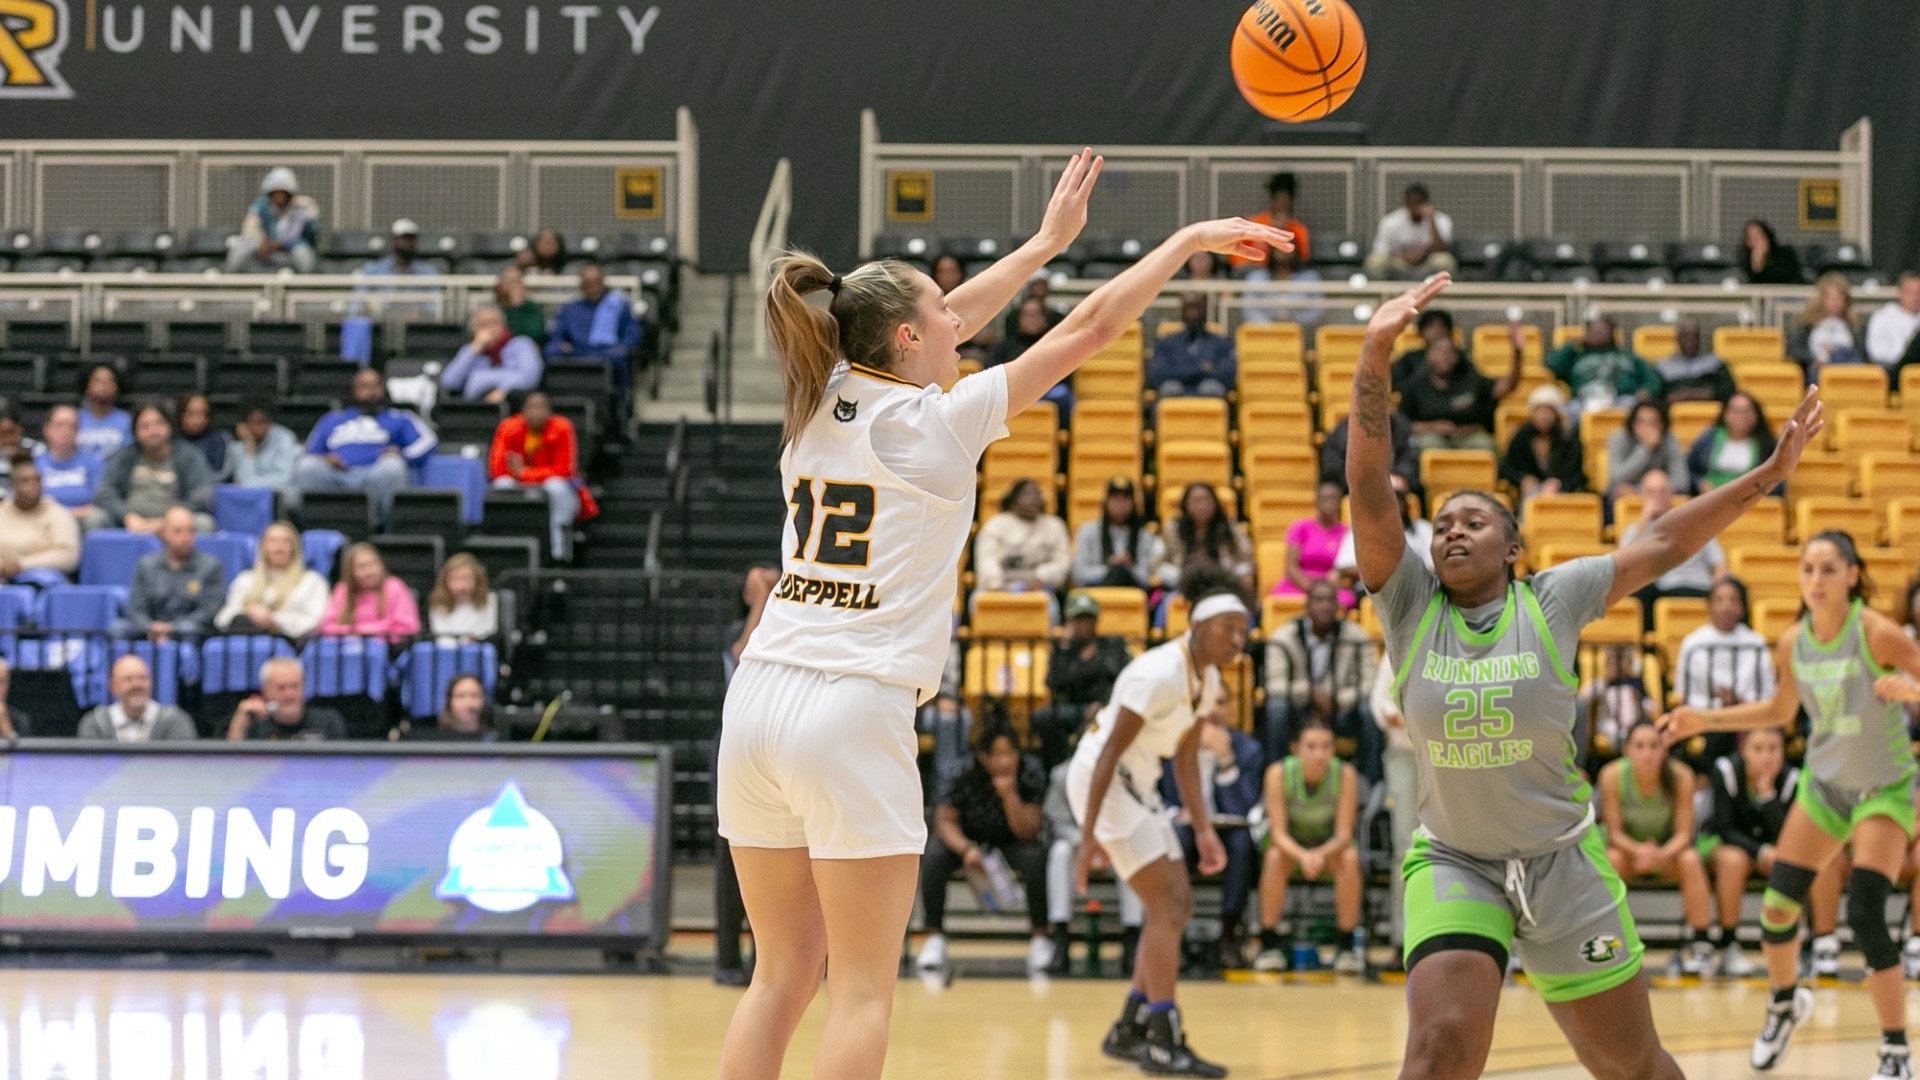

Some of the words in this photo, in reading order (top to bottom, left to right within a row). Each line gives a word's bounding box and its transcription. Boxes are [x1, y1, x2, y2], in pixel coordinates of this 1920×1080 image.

[102, 5, 660, 54] UNIVERSITY
[789, 475, 877, 569] 12
[774, 572, 881, 610] OEPPELL
[1422, 650, 1540, 684] RUNNING
[1443, 686, 1513, 739] 25
[1427, 739, 1532, 769] EAGLES
[0, 805, 370, 900] MBING
